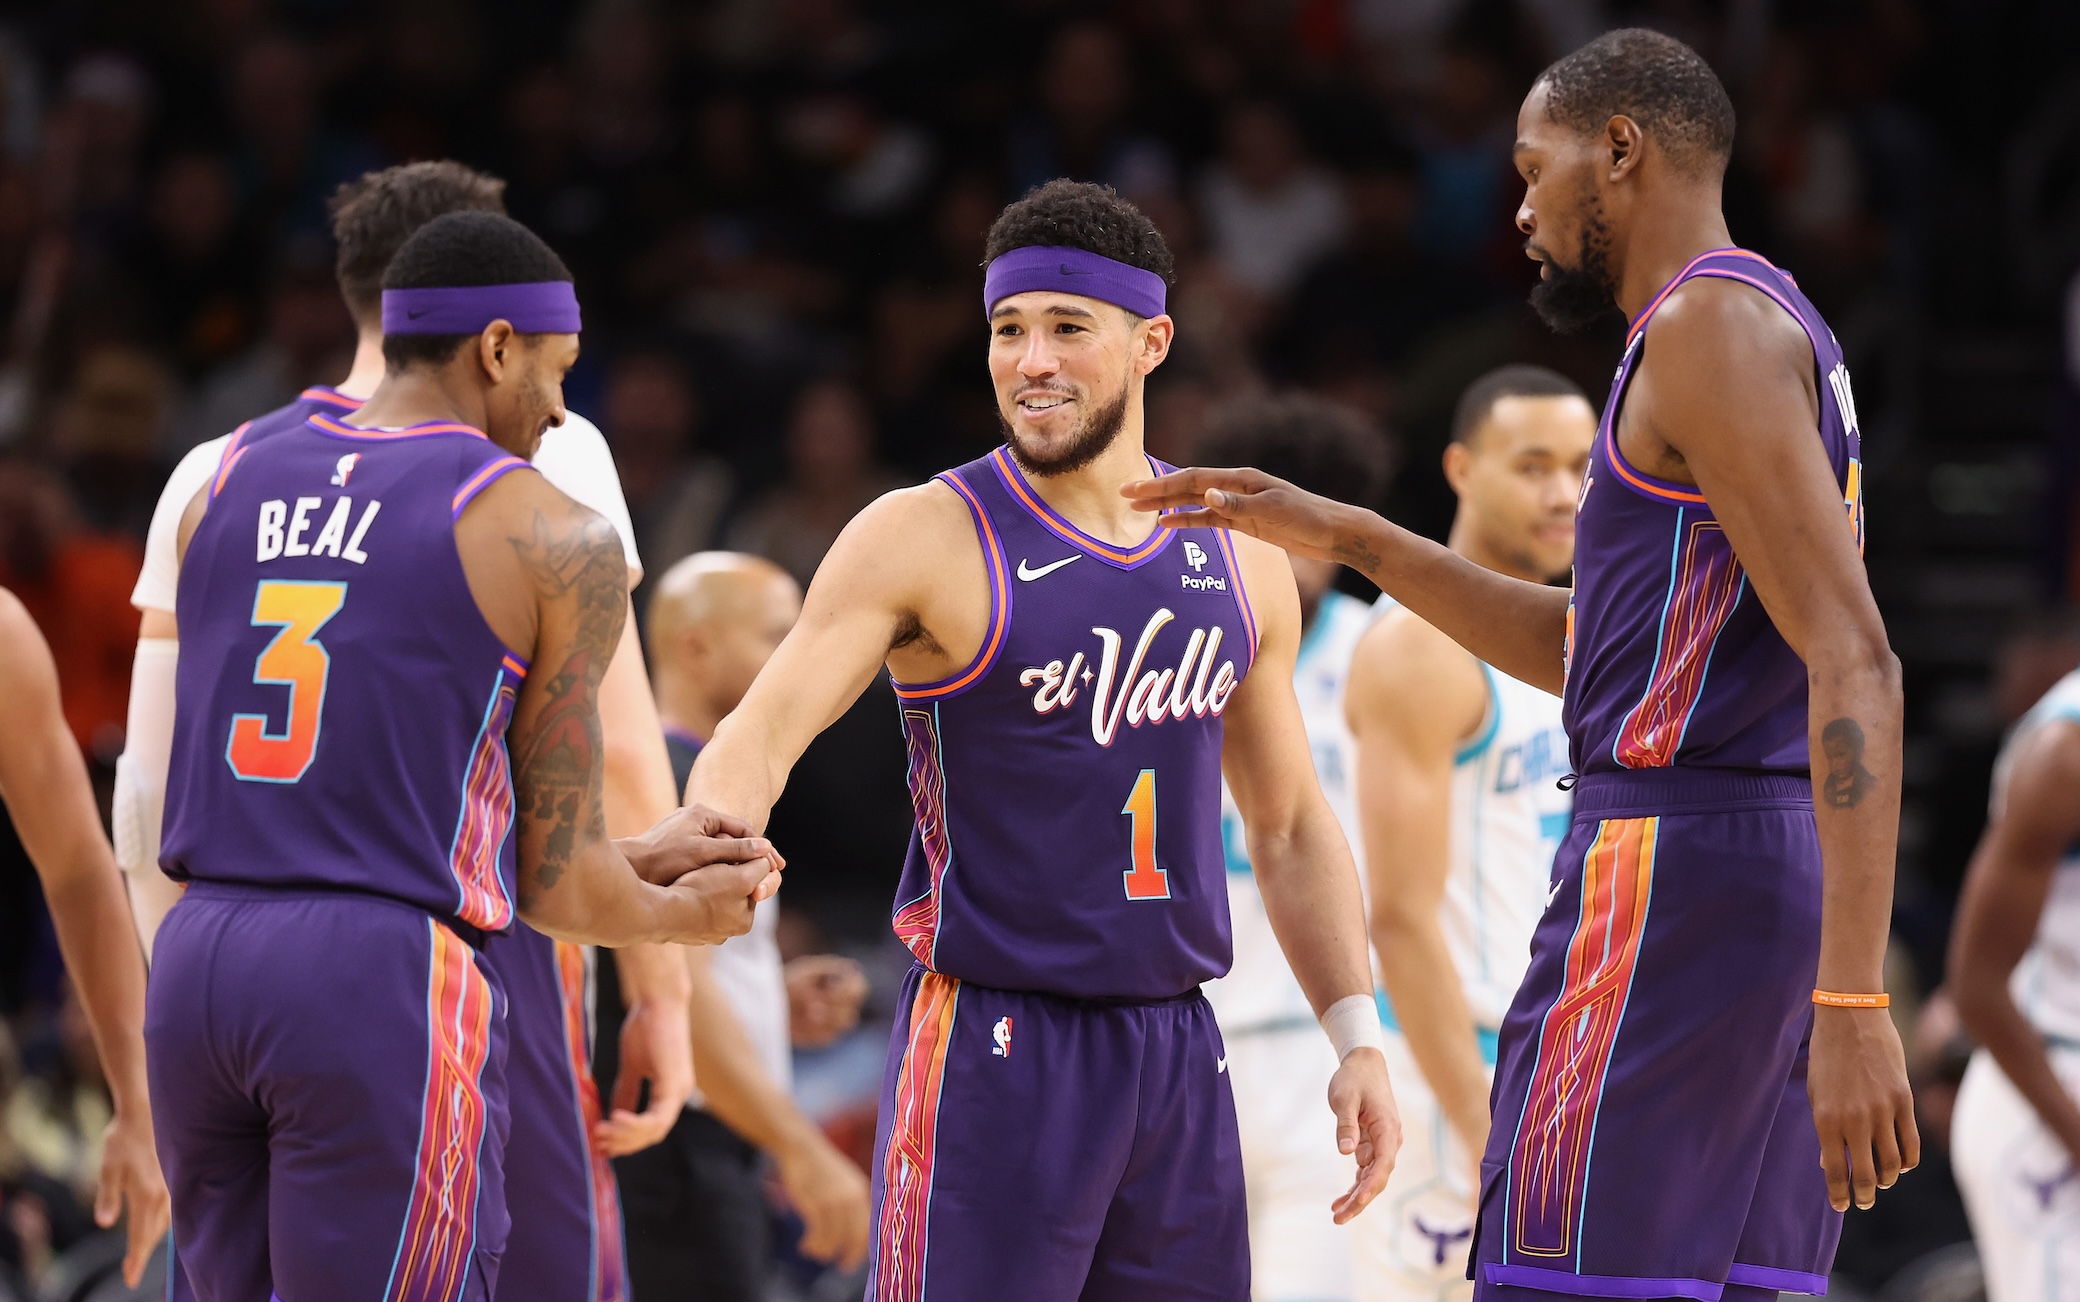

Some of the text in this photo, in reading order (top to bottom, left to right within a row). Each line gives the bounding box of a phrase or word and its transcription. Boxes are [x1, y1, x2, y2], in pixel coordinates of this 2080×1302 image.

[256, 496, 381, 565] BEAL
[1181, 574, 1227, 592] PayPal
[225, 579, 348, 784] 3
[1019, 607, 1239, 747] El Valle
[1121, 768, 1171, 900] 1
